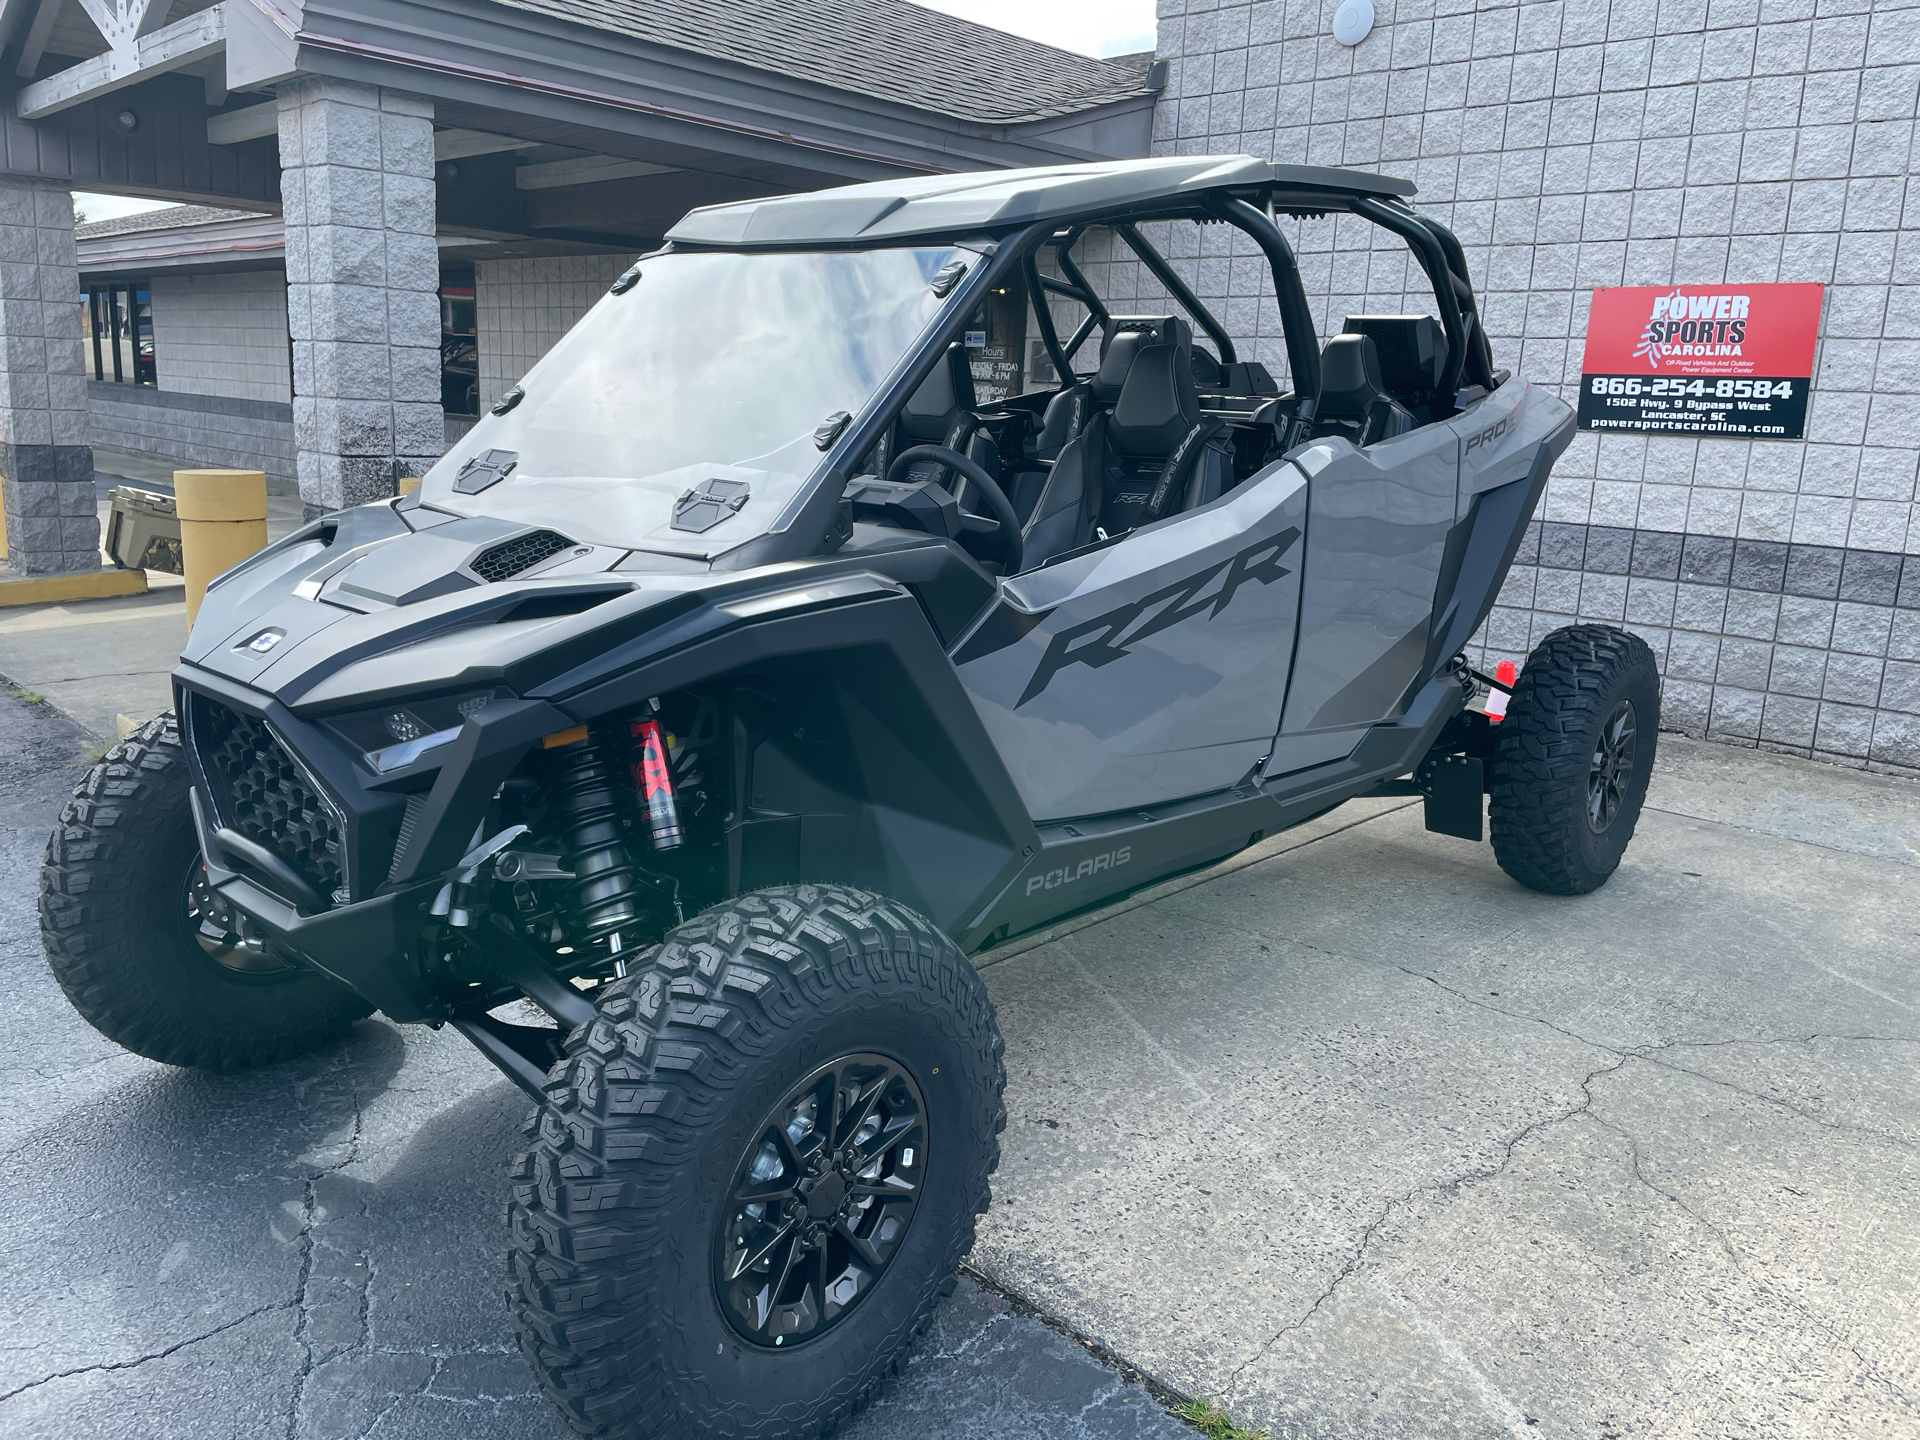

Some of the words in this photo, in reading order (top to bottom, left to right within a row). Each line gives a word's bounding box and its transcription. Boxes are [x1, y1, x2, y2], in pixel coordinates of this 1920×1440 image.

[1652, 295, 1750, 319] POWER
[1648, 320, 1746, 344] SPORTS
[981, 346, 1005, 357] Hours
[1661, 344, 1742, 356] CAROLINA
[1692, 359, 1716, 367] Vehicles
[1701, 366, 1732, 374] Equipment
[995, 372, 1000, 380] 6
[1000, 372, 1011, 380] PM
[975, 386, 1008, 396] SATURDAY
[1591, 377, 1793, 399] 866-254-8584
[1606, 397, 1637, 407] 1502
[1640, 398, 1669, 410] Hwy.
[1673, 399, 1683, 409] 9
[1686, 400, 1734, 411] Bypass
[1737, 401, 1772, 411] West
[1641, 409, 1707, 422] Lancaster,
[1710, 412, 1726, 421] SC
[1591, 419, 1785, 433] powersportscarolina.com
[1174, 423, 1201, 463] RZR
[1464, 417, 1507, 457] PRO
[1013, 525, 1302, 712] RZR
[1025, 845, 1132, 897] POLARIS
